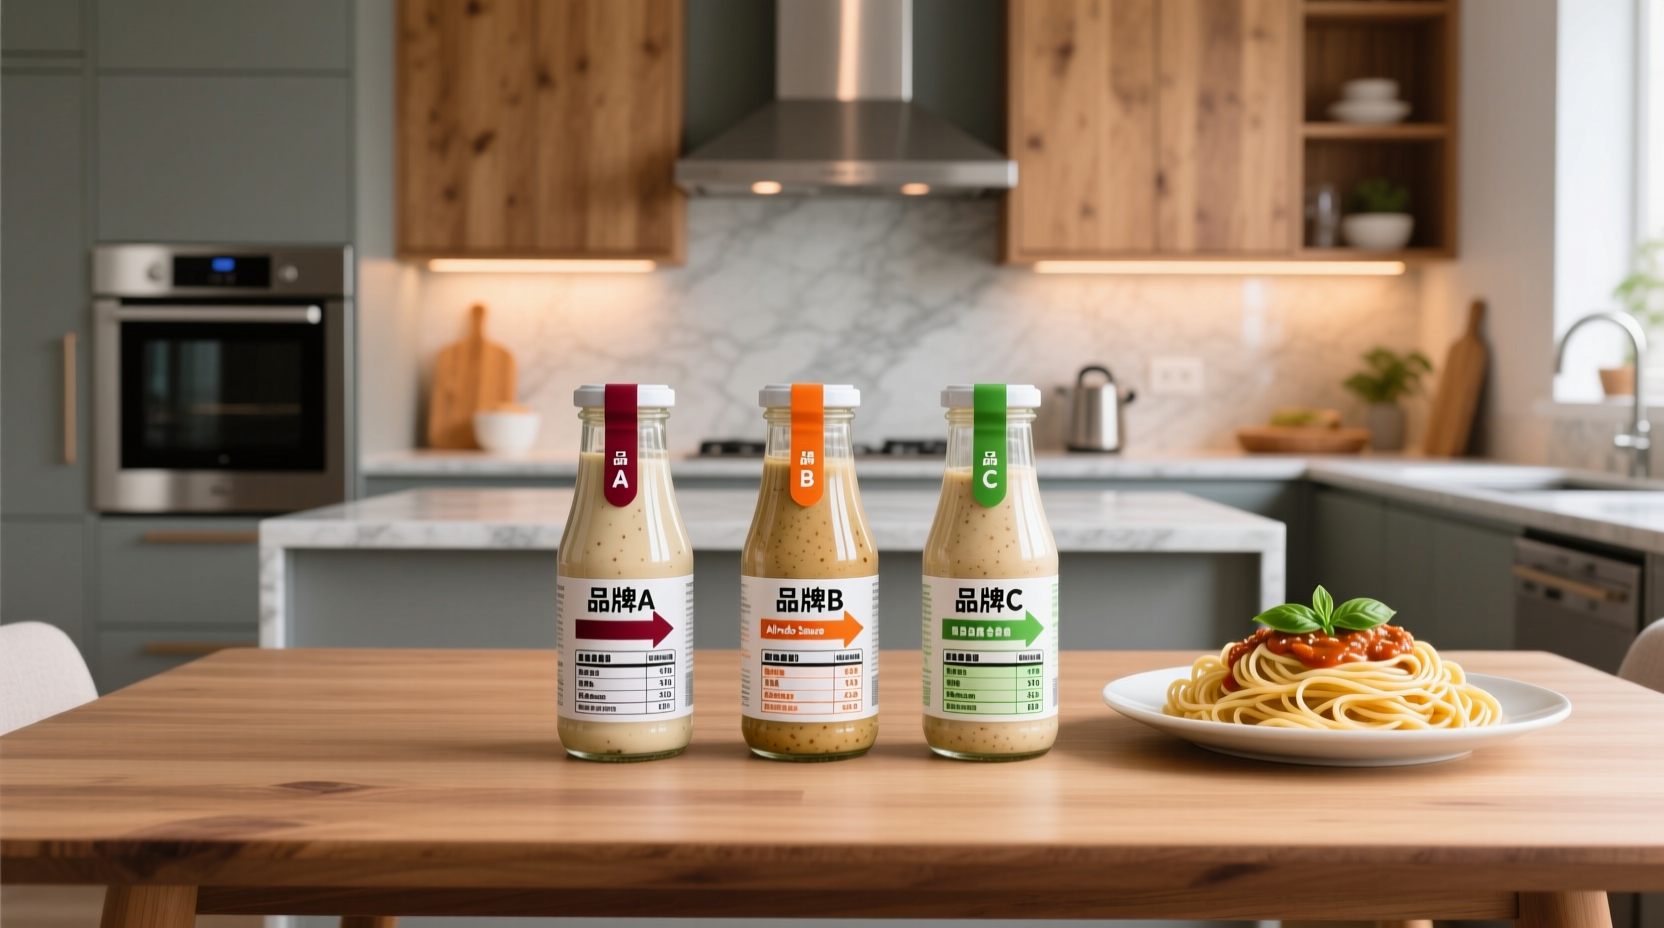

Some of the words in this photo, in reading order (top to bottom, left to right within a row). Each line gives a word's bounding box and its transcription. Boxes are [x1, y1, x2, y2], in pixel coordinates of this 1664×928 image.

[612, 469, 629, 489] A
[800, 469, 815, 488] B
[982, 469, 998, 489] C
[587, 586, 656, 614] 品牌A
[776, 586, 844, 614] 品牌B
[955, 586, 1023, 614] 品牌C
